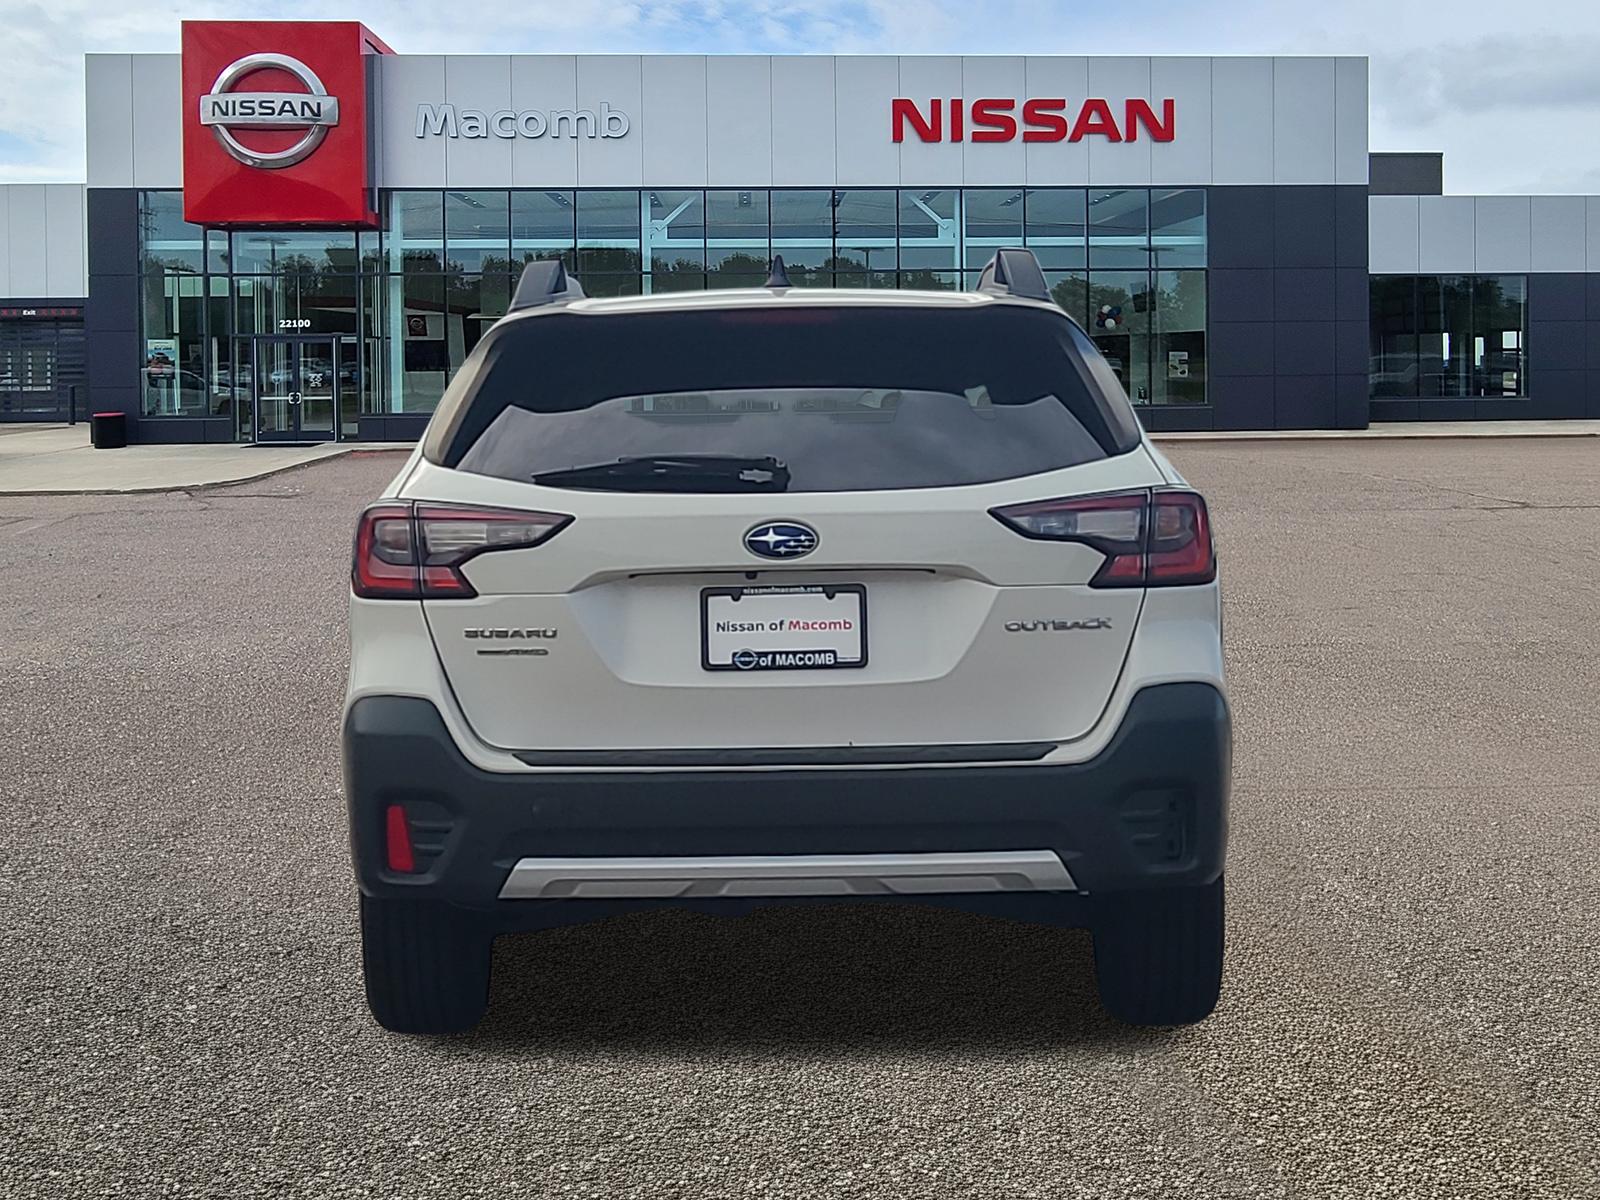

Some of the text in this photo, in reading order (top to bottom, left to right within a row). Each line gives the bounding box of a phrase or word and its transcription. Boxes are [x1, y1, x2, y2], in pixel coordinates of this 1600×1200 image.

[211, 99, 322, 118] NISSAN
[415, 103, 629, 139] Macomb
[892, 98, 1175, 143] NISSAN
[279, 319, 311, 328] 22100
[743, 586, 823, 594] nissanofmacomb.com
[716, 619, 852, 632] Nissan of Macomb
[1004, 617, 1112, 632] OUTBACK
[464, 628, 558, 639] SUBARU
[759, 653, 835, 667] of MACOMB
